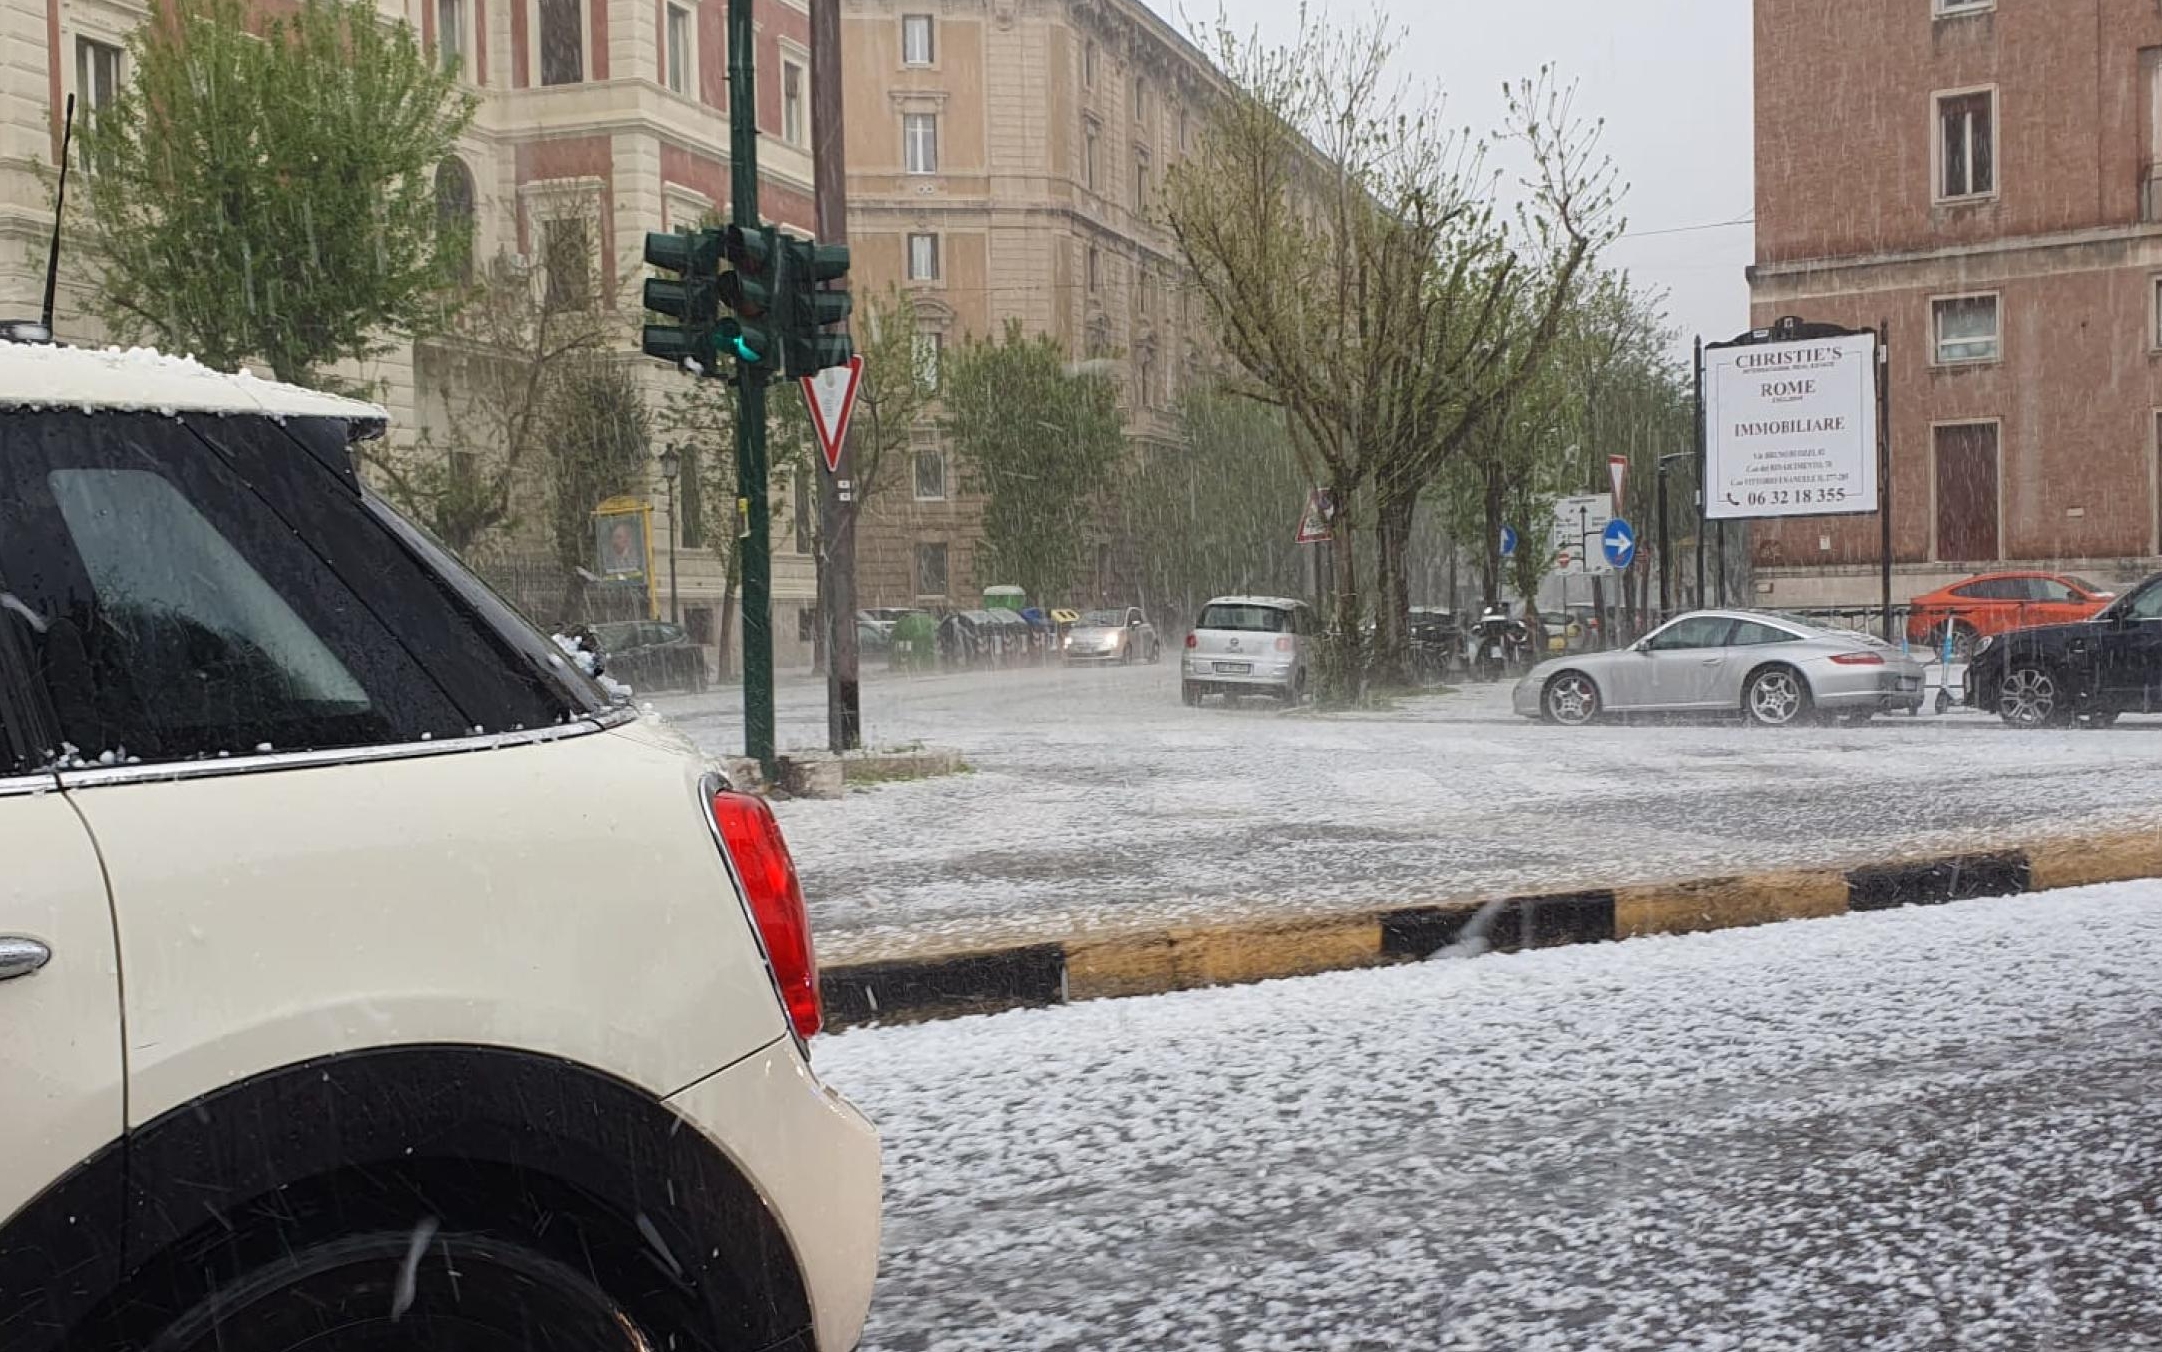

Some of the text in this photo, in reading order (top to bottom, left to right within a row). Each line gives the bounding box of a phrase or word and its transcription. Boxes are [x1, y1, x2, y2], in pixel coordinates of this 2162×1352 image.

[1735, 346, 1842, 368] CHRISTIE'S
[1761, 380, 1816, 397] ROME
[1735, 416, 1845, 437] IMMOBILIARE
[1747, 487, 1846, 505] 06 32 18 355
